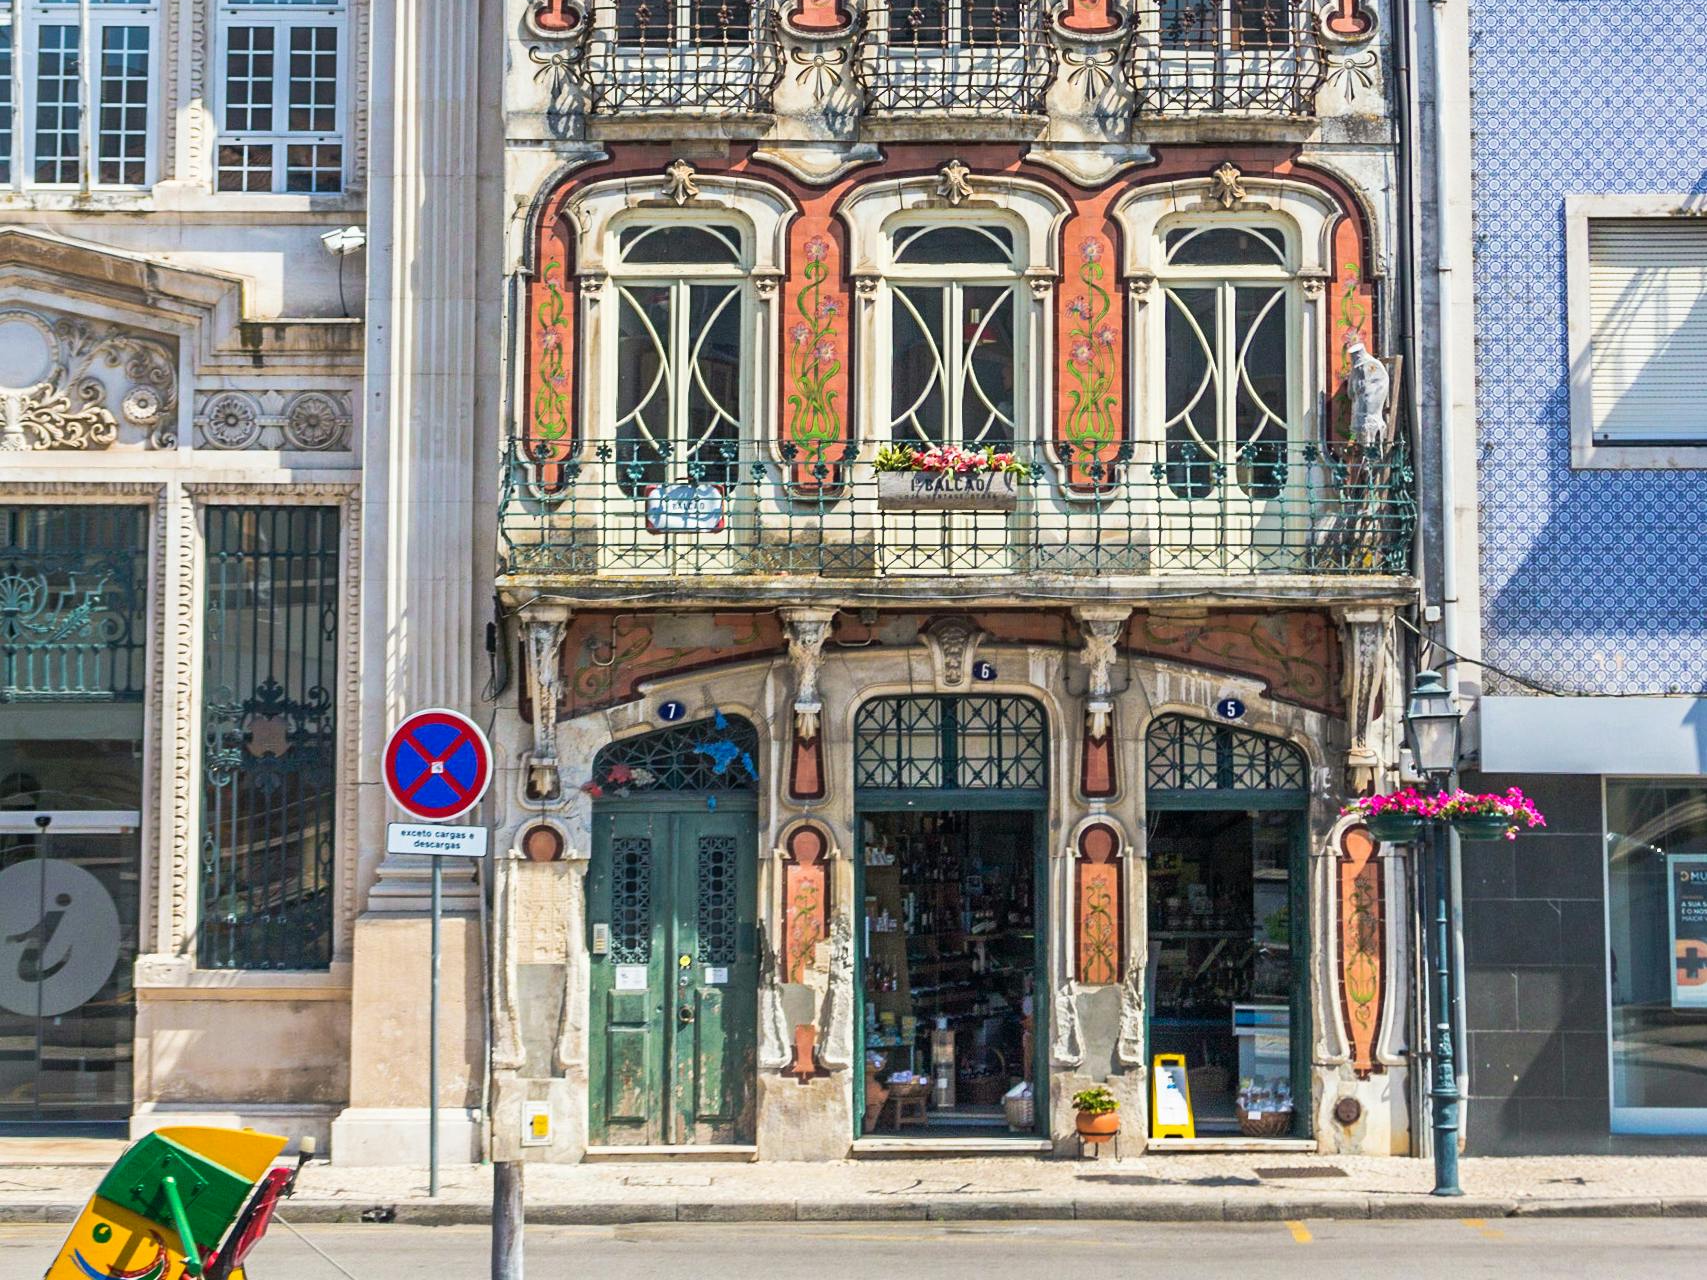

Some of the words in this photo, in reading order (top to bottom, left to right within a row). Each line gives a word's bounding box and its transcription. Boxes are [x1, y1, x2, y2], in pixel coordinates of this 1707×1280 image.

[981, 663, 990, 679] 6
[667, 703, 676, 719] 7
[1227, 701, 1236, 717] 5
[435, 831, 466, 839] cargas
[414, 840, 460, 850] descargas
